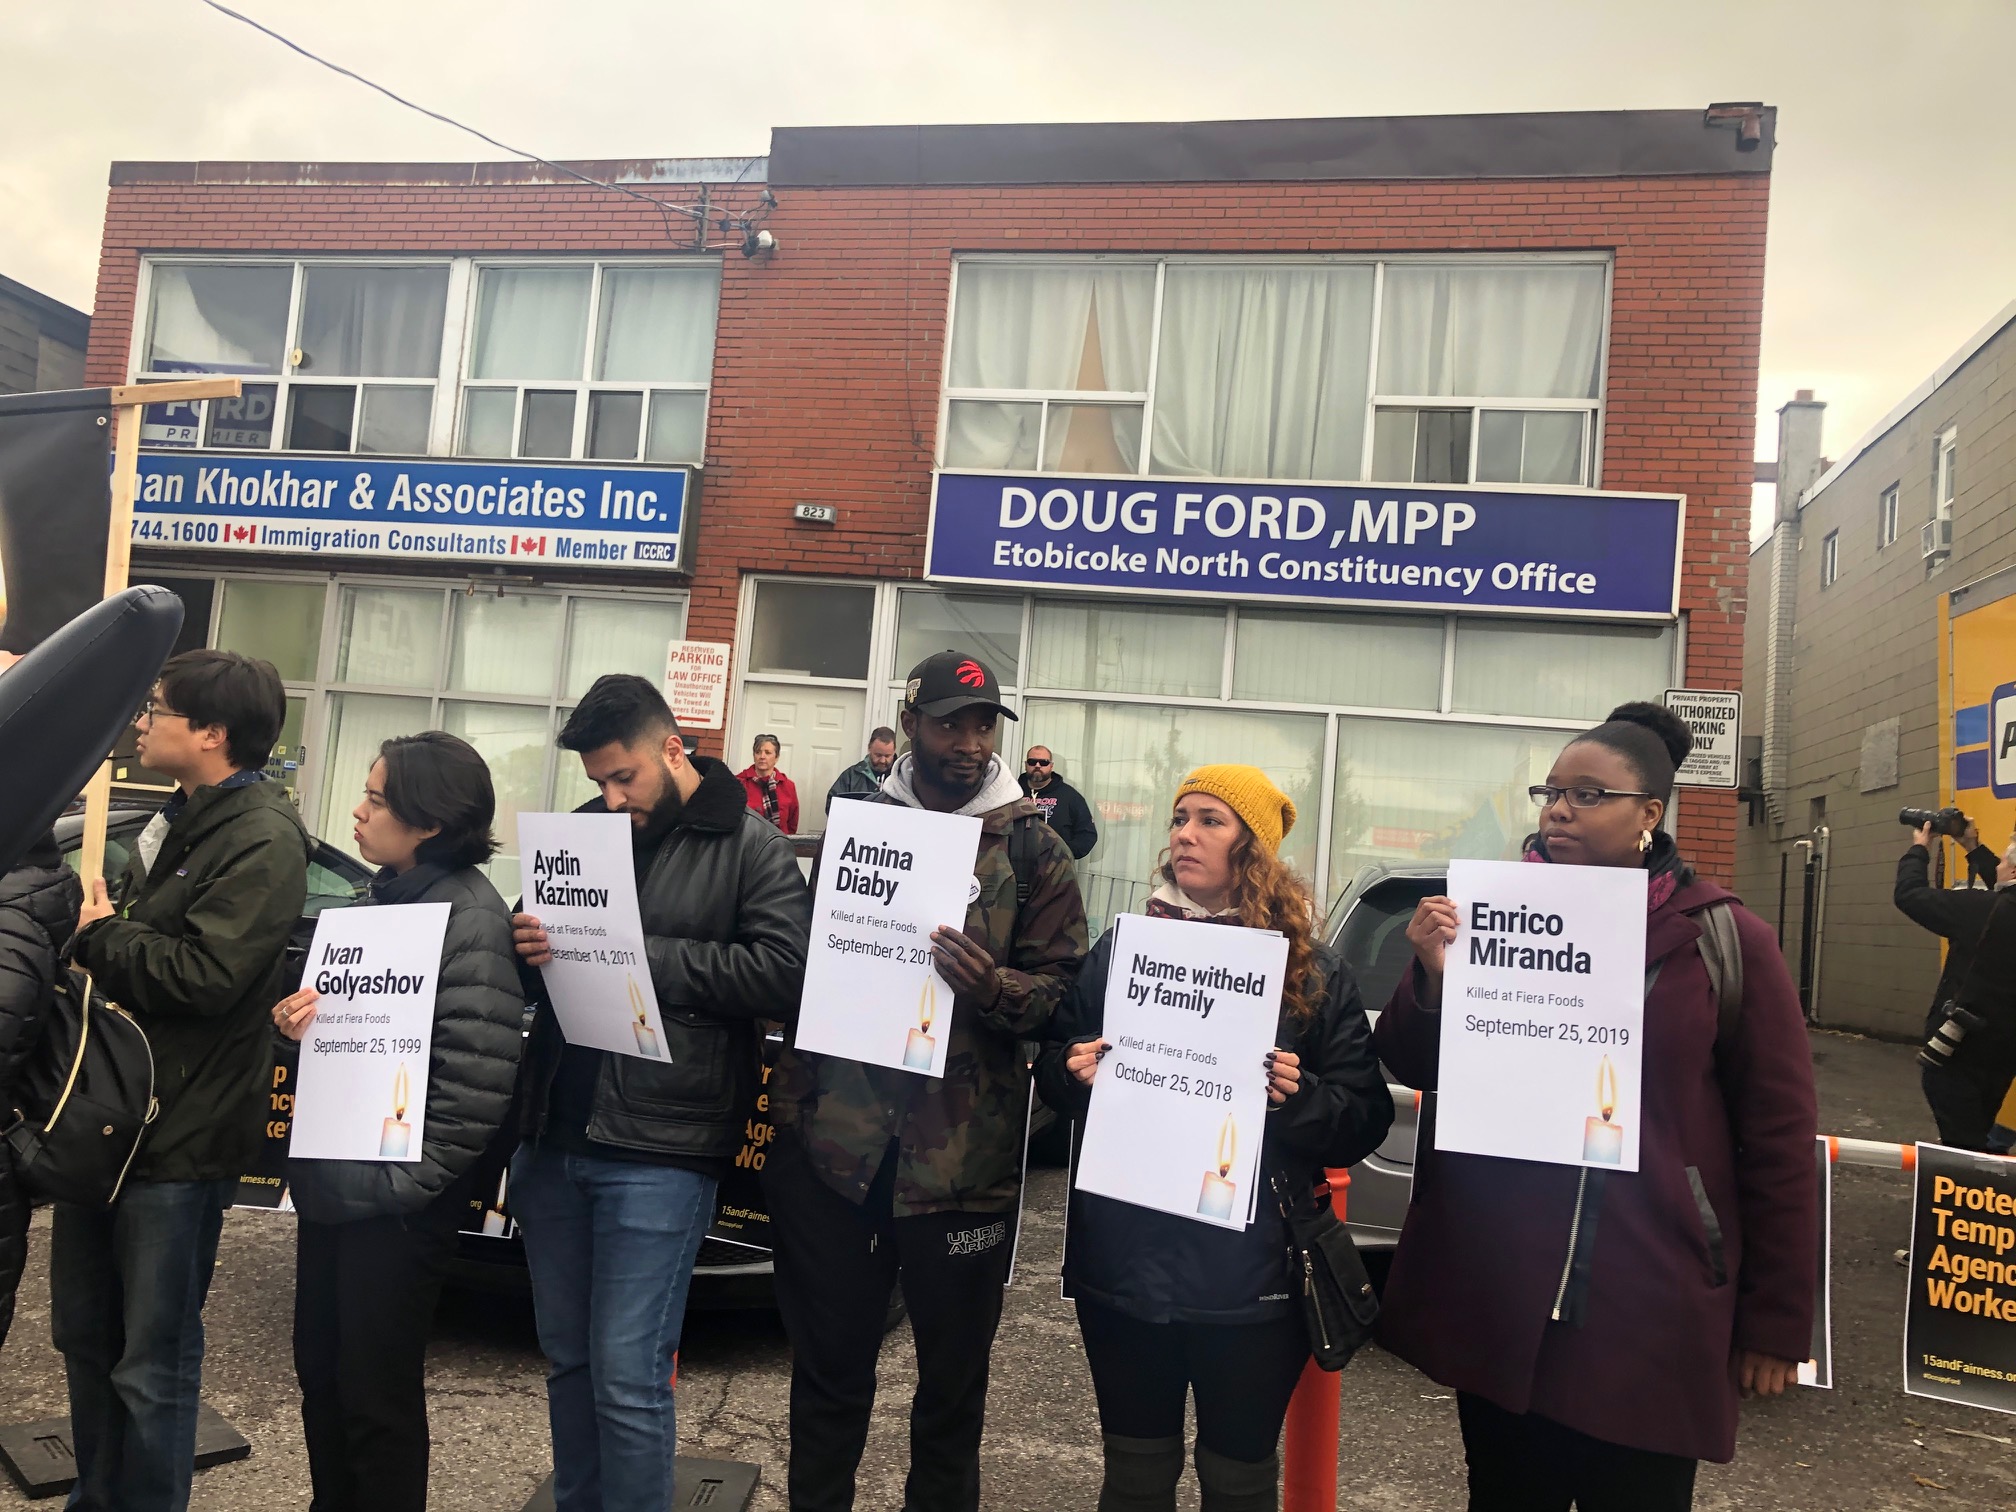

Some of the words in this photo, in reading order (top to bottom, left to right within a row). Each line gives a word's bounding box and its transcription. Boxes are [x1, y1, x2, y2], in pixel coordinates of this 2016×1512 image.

[195, 468, 338, 510] Khokhar
[349, 472, 375, 510] &
[386, 474, 586, 518] Associates
[600, 482, 668, 522] Inc.
[802, 507, 826, 519] 823
[999, 487, 1158, 535] DOUG
[261, 525, 380, 551] Immigration
[388, 529, 506, 555] Consultants
[555, 538, 628, 560] Member
[638, 544, 671, 560] ICCRC
[993, 541, 1147, 573] Etobicoke
[1155, 548, 1249, 580] North
[1258, 552, 1483, 596] Constituency
[1491, 563, 1597, 595] Office
[671, 651, 723, 666] PARKING
[682, 646, 715, 654] RESERVED
[668, 671, 688, 680] LAW
[691, 673, 722, 683] OFFICE
[675, 682, 713, 690] Unauthorized
[674, 690, 698, 698] Vehicles
[534, 850, 581, 881] Aydin
[840, 837, 913, 871] Amina
[535, 880, 608, 908] Kazimov
[836, 867, 899, 906] Diaby
[557, 926, 564, 934] at
[565, 925, 583, 935] Fiera
[584, 926, 607, 936] Foods
[831, 910, 854, 923] Killed
[857, 914, 865, 925] at
[867, 915, 888, 929] Fiera
[890, 919, 917, 934] Foods
[1471, 902, 1563, 936] Enrico
[321, 943, 363, 965] Ivan
[593, 949, 611, 966] 14,
[610, 950, 637, 965] 2011
[827, 934, 893, 959] September
[896, 946, 907, 964] 2,
[910, 949, 933, 966] 201
[1469, 936, 1592, 974] Miranda
[315, 968, 424, 1001] Golyashov
[1131, 953, 1187, 982] Name
[1192, 965, 1266, 997] witheld
[1127, 978, 1149, 1006] by
[1154, 982, 1215, 1018] family
[1466, 987, 1498, 1000] Killed
[1501, 990, 1512, 1002] at
[1516, 991, 1544, 1005] Fiera
[1548, 993, 1584, 1008] Foods
[316, 1014, 335, 1024] Killed
[336, 1014, 344, 1024] at
[345, 1014, 363, 1024] Fiera
[365, 1014, 391, 1024] Foods
[1465, 1014, 1554, 1039] September
[1558, 1023, 1583, 1044] 25,
[1587, 1026, 1629, 1045] 2019
[313, 1038, 368, 1056] September
[369, 1039, 387, 1055] 25,
[392, 1038, 422, 1053] 1999
[1118, 1035, 1144, 1050] Killed
[1146, 1041, 1155, 1053] at
[1158, 1043, 1183, 1059] Fiera
[1185, 1049, 1218, 1066] Foods
[1115, 1062, 1167, 1089] October
[1169, 1074, 1191, 1096] 25,
[1195, 1079, 1233, 1102] 2018
[1932, 1208, 2015, 1255] Temp
[1927, 1244, 2016, 1286] Agenc
[1927, 1277, 2016, 1322] Worke
